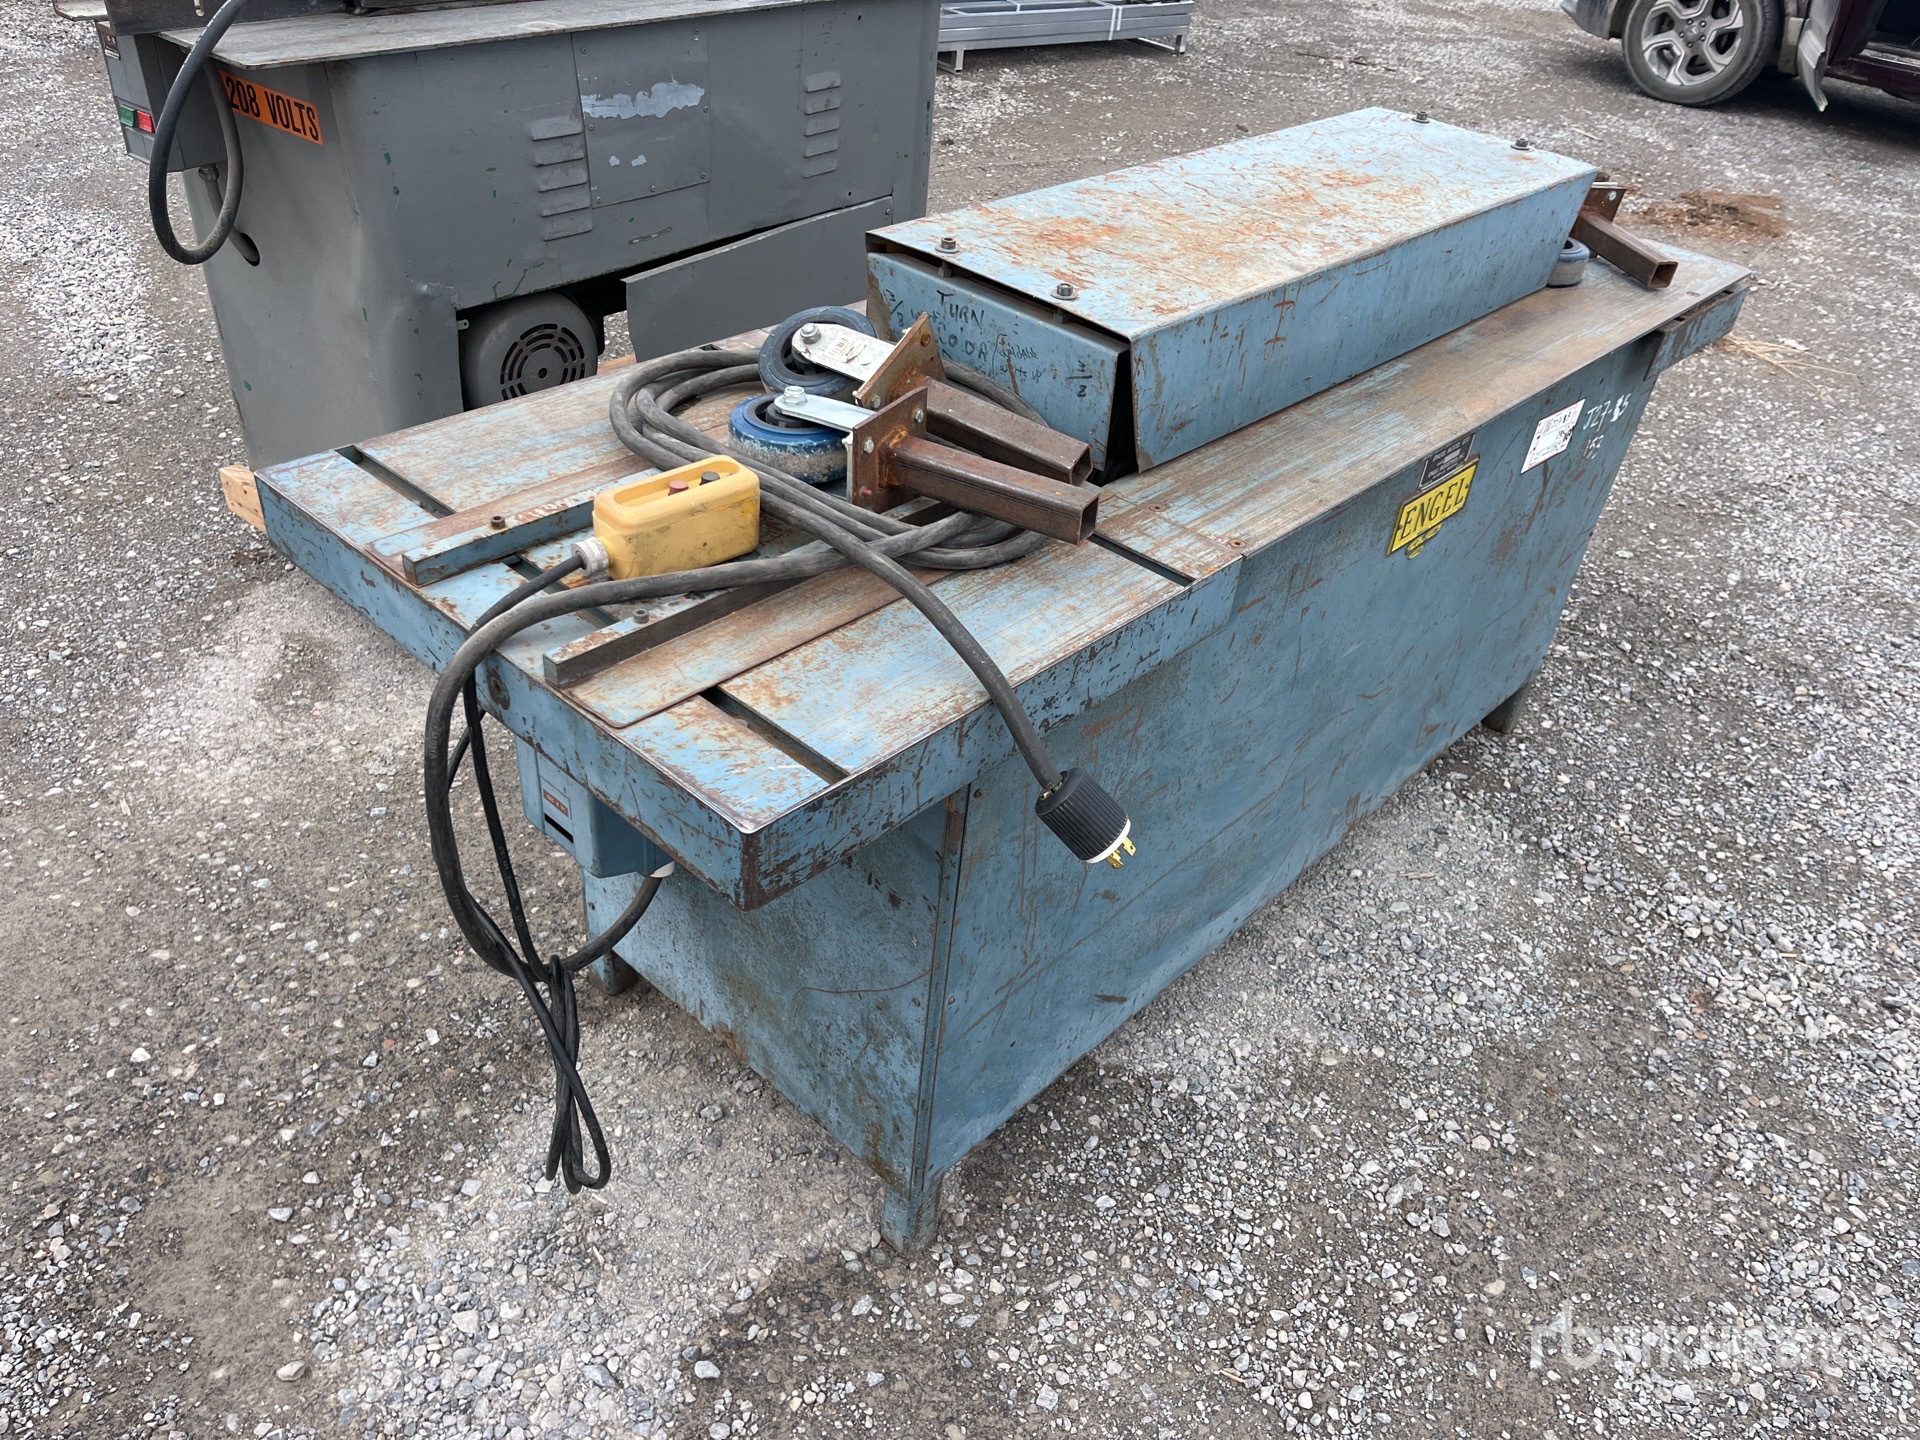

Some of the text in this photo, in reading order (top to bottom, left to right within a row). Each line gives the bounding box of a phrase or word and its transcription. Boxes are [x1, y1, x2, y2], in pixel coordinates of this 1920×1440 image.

[226, 76, 320, 141] 208 VOLTS
[1400, 477, 1466, 542] ENGEL
